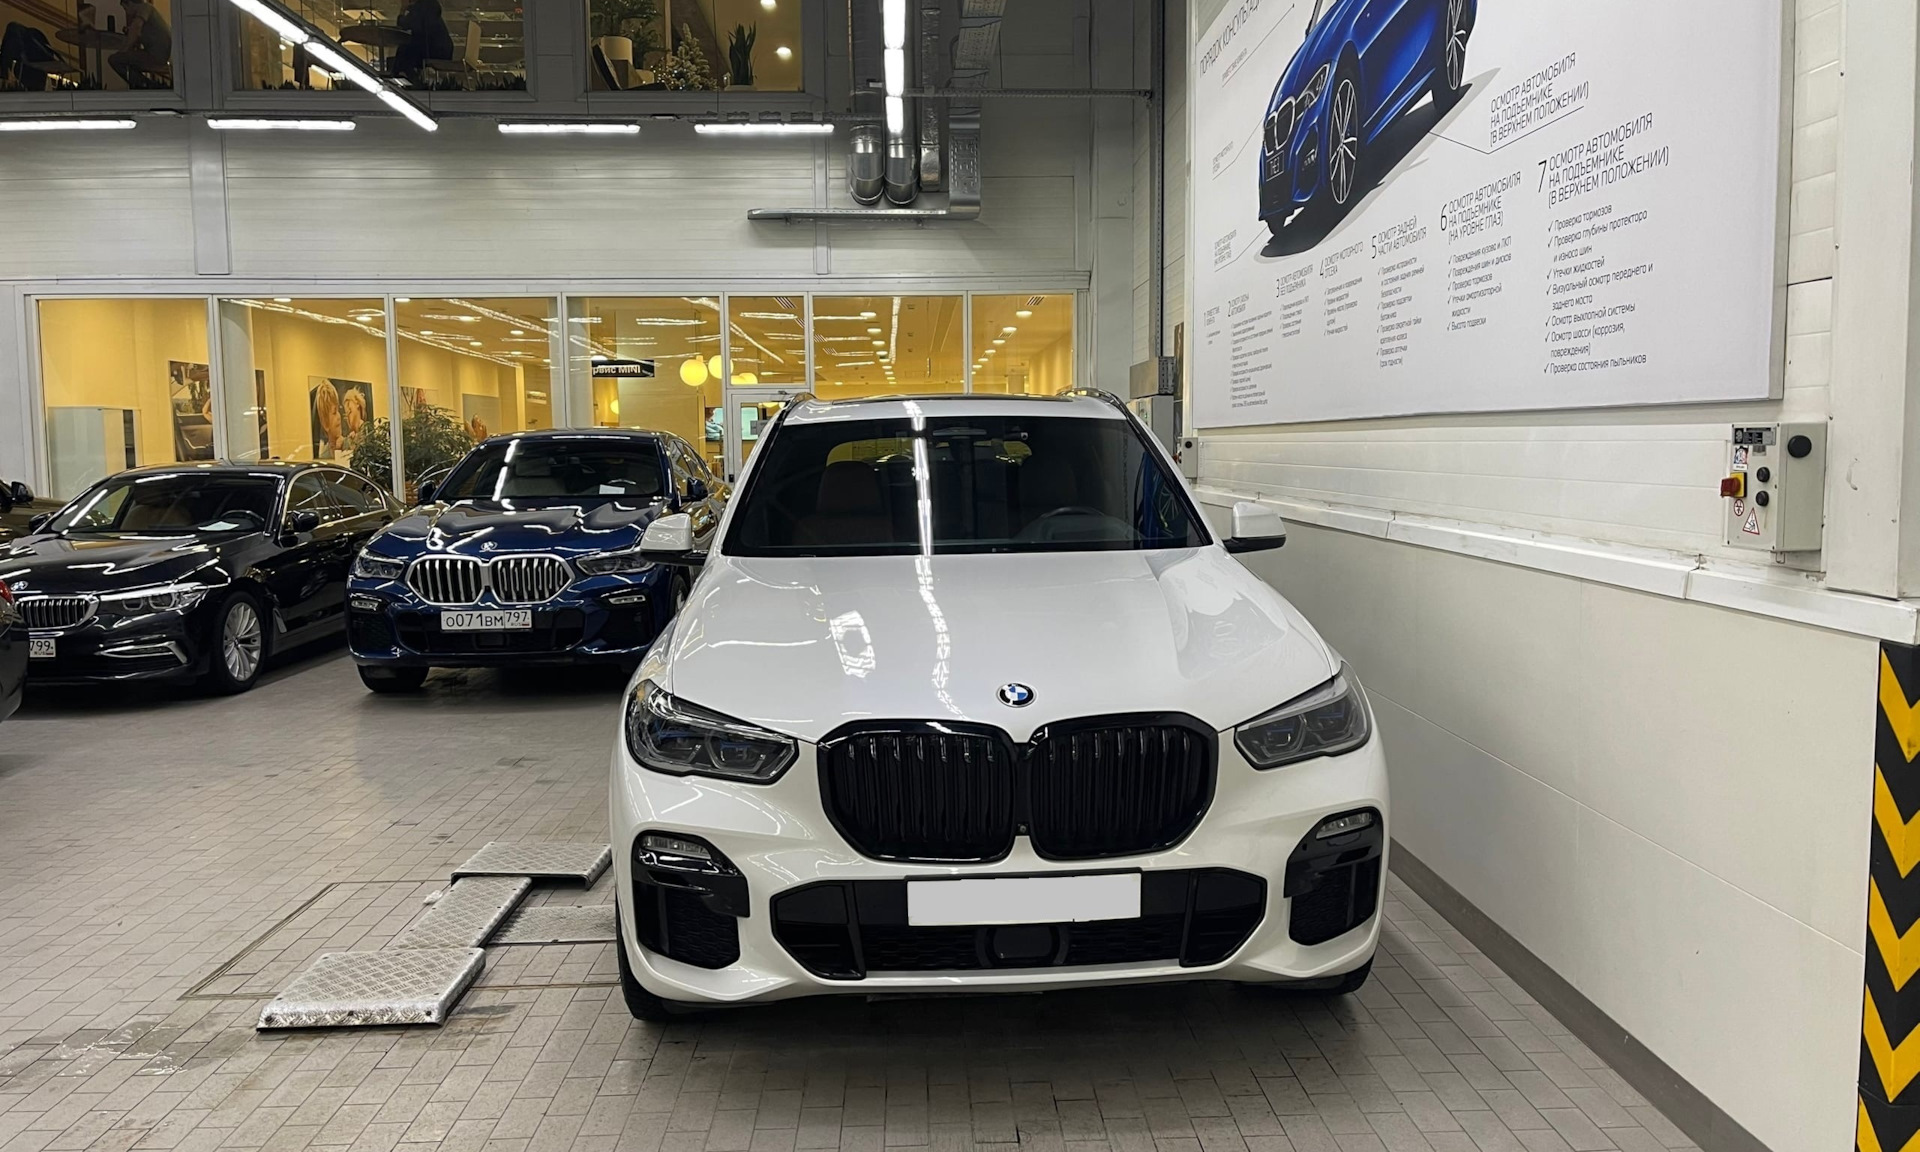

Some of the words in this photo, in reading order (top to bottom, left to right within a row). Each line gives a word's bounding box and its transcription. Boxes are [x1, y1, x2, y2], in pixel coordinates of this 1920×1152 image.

[1491, 85, 1520, 113] ОСМОТР
[1521, 52, 1576, 96] АВТОМОБИЛЯ
[1490, 112, 1501, 129] НА
[1502, 82, 1553, 122] ПОДЪЕМНИКЕ
[1490, 129, 1498, 147] (В
[1498, 111, 1532, 141] ВЕРХНЕМ
[1534, 80, 1589, 122] ПОЛОЖЕНИИ)
[1550, 143, 1585, 171] ОСМОТР
[1586, 112, 1653, 154] АВТОМОБИЛЯ
[1538, 160, 1547, 193] 7
[1549, 172, 1561, 189] НА
[1562, 144, 1625, 185] ПОДЪЕМНИКЕ
[1549, 190, 1557, 209] (В
[1558, 174, 1600, 203] ВЕРХНЕМ
[1601, 145, 1669, 186] ПОЛОЖЕНИИ)
[1449, 192, 1474, 213] ОСМОТР
[1474, 171, 1521, 201] АВТОМОБИЛЯ
[1440, 204, 1448, 231] 6
[1449, 215, 1457, 229] НА
[1457, 195, 1502, 224] ПОДЪЕМНИКЕ
[1459, 217, 1484, 239] УРОВНЕ
[1484, 211, 1504, 231] ГЛАЗ)
[1554, 213, 1582, 231] Проверка
[1582, 204, 1612, 223] тормозов
[1553, 229, 1582, 248] Проверка
[1582, 223, 1608, 239] глубины
[1609, 210, 1648, 231] протектора
[1372, 235, 1377, 259] 5
[1558, 248, 1578, 262] износа
[1579, 244, 1593, 256] шин
[1552, 276, 1588, 295] Визуальный
[1588, 273, 1611, 287] осмотр
[1611, 265, 1647, 283] переднего
[1553, 266, 1573, 279] Утечки
[1573, 255, 1605, 275] жидкостей
[1551, 312, 1573, 327] Осмотр
[1573, 307, 1607, 323] выхлопной
[1607, 303, 1636, 317] системы
[1552, 296, 1575, 311] заднего
[1575, 294, 1593, 306] моста
[1551, 329, 1573, 343] Осмотр
[1573, 328, 1592, 339] шасси
[592, 366, 616, 375] рвис
[1550, 362, 1577, 375] Проверка
[1577, 358, 1609, 371] состояния
[1609, 353, 1647, 367] пыльников
[506, 611, 528, 623] 797
[30, 640, 51, 651] 799
